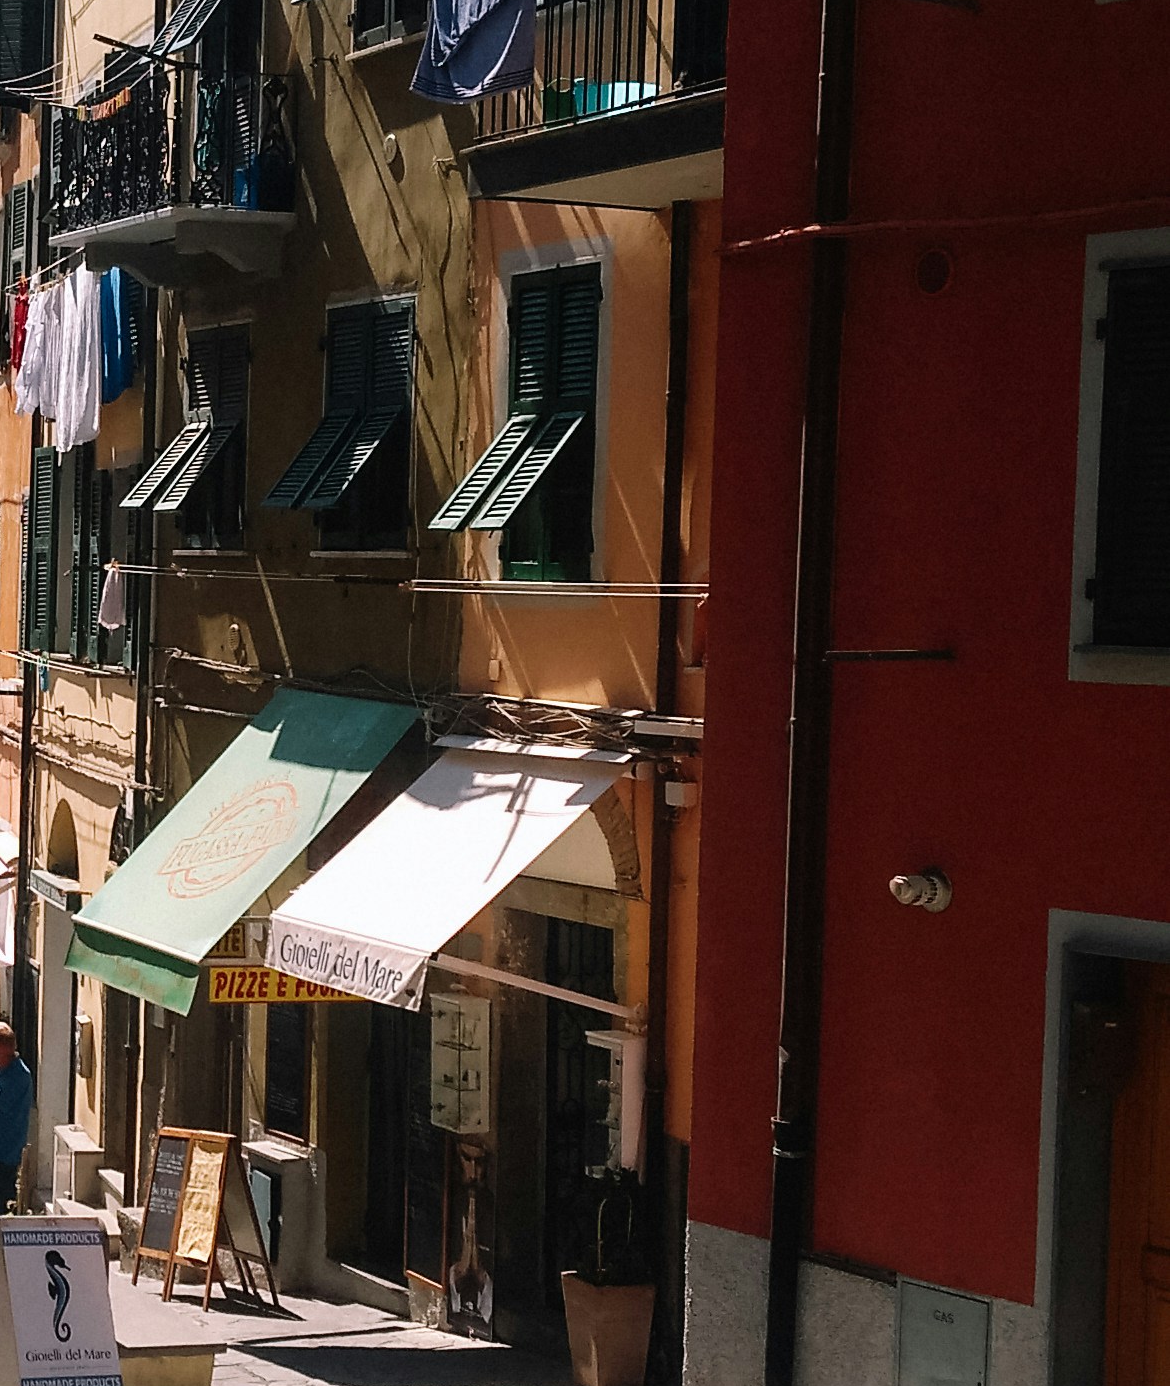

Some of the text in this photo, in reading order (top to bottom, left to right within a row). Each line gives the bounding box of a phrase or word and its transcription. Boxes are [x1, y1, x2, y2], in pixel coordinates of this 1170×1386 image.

[280, 934, 404, 994] Gioielli del Mare
[215, 971, 271, 999] PIZZE
[277, 972, 289, 997] E
[3, 1232, 100, 1244] HANDMADE PRODUCTS
[933, 1310, 955, 1324] GAS
[25, 1349, 112, 1362] Gioielli del Mare
